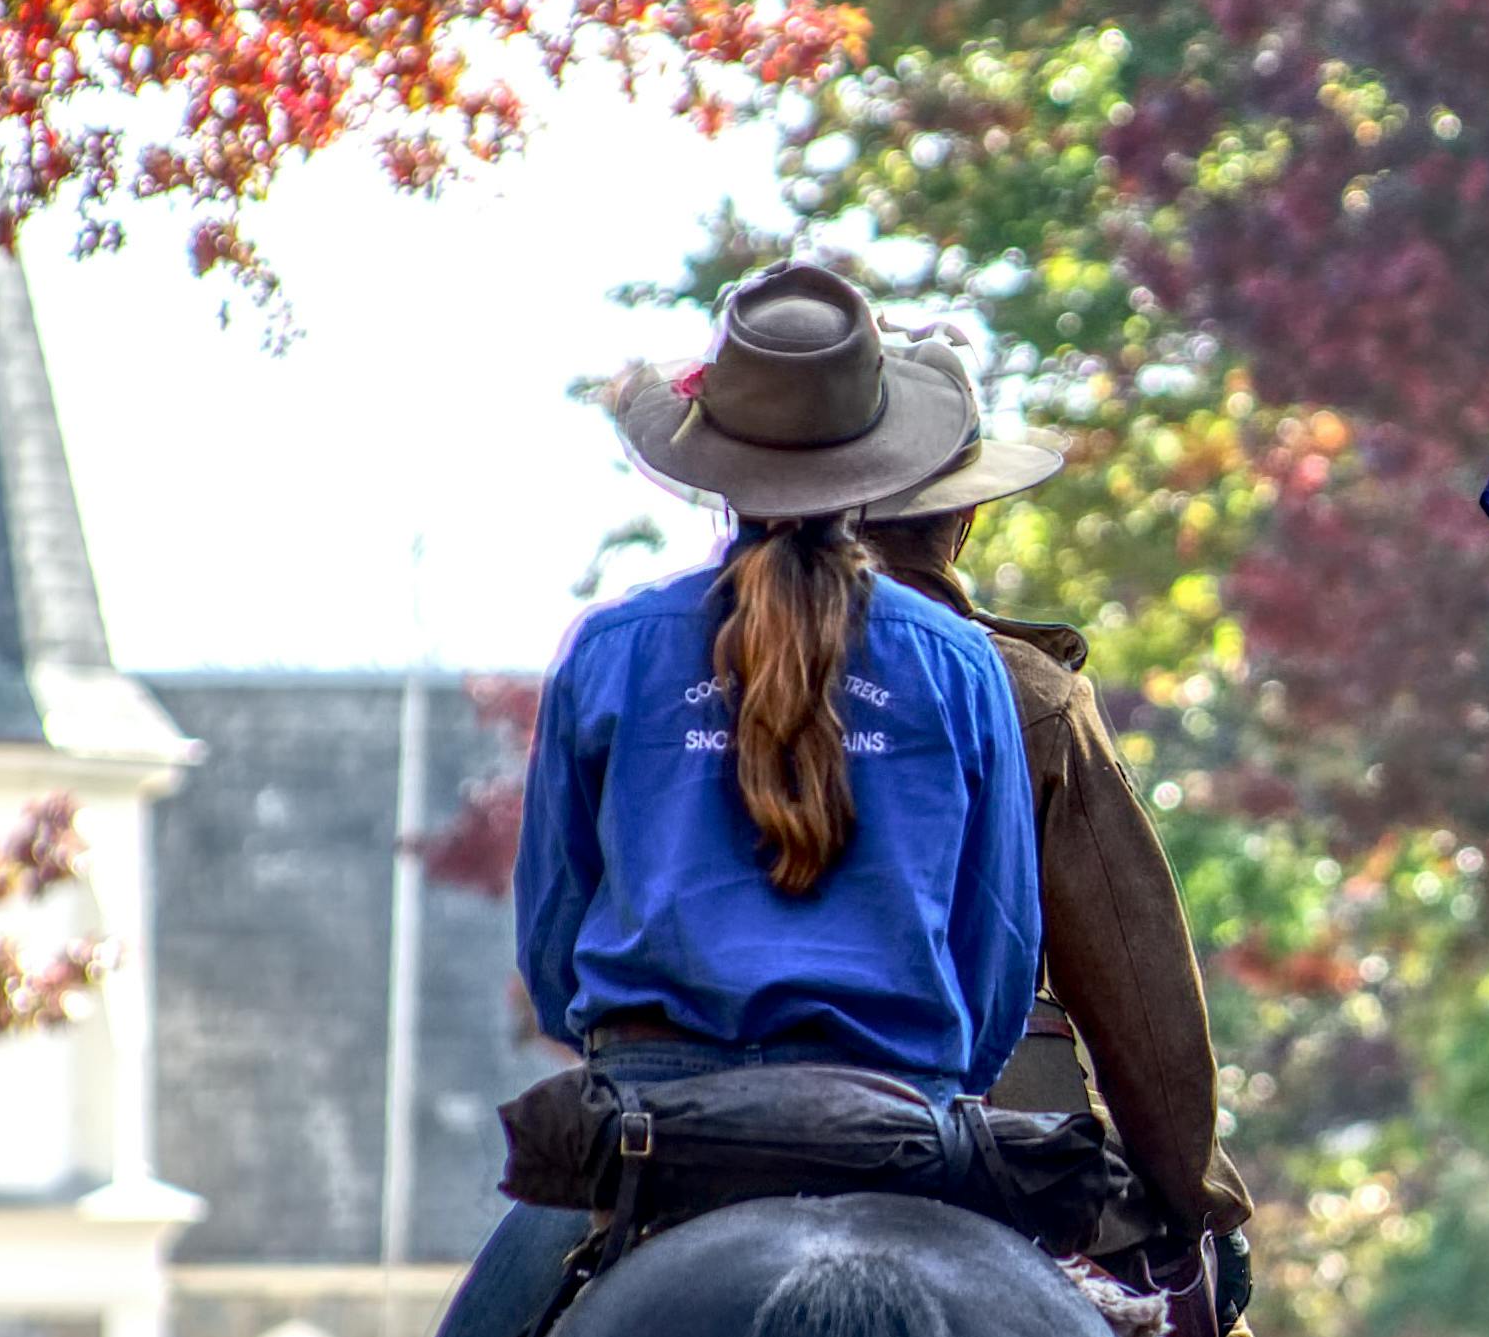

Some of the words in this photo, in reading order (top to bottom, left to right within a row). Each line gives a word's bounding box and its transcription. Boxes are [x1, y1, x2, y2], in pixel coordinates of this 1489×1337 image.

[844, 674, 890, 707] TREKS
[685, 729, 728, 750] SNO
[841, 730, 885, 753] AINS
